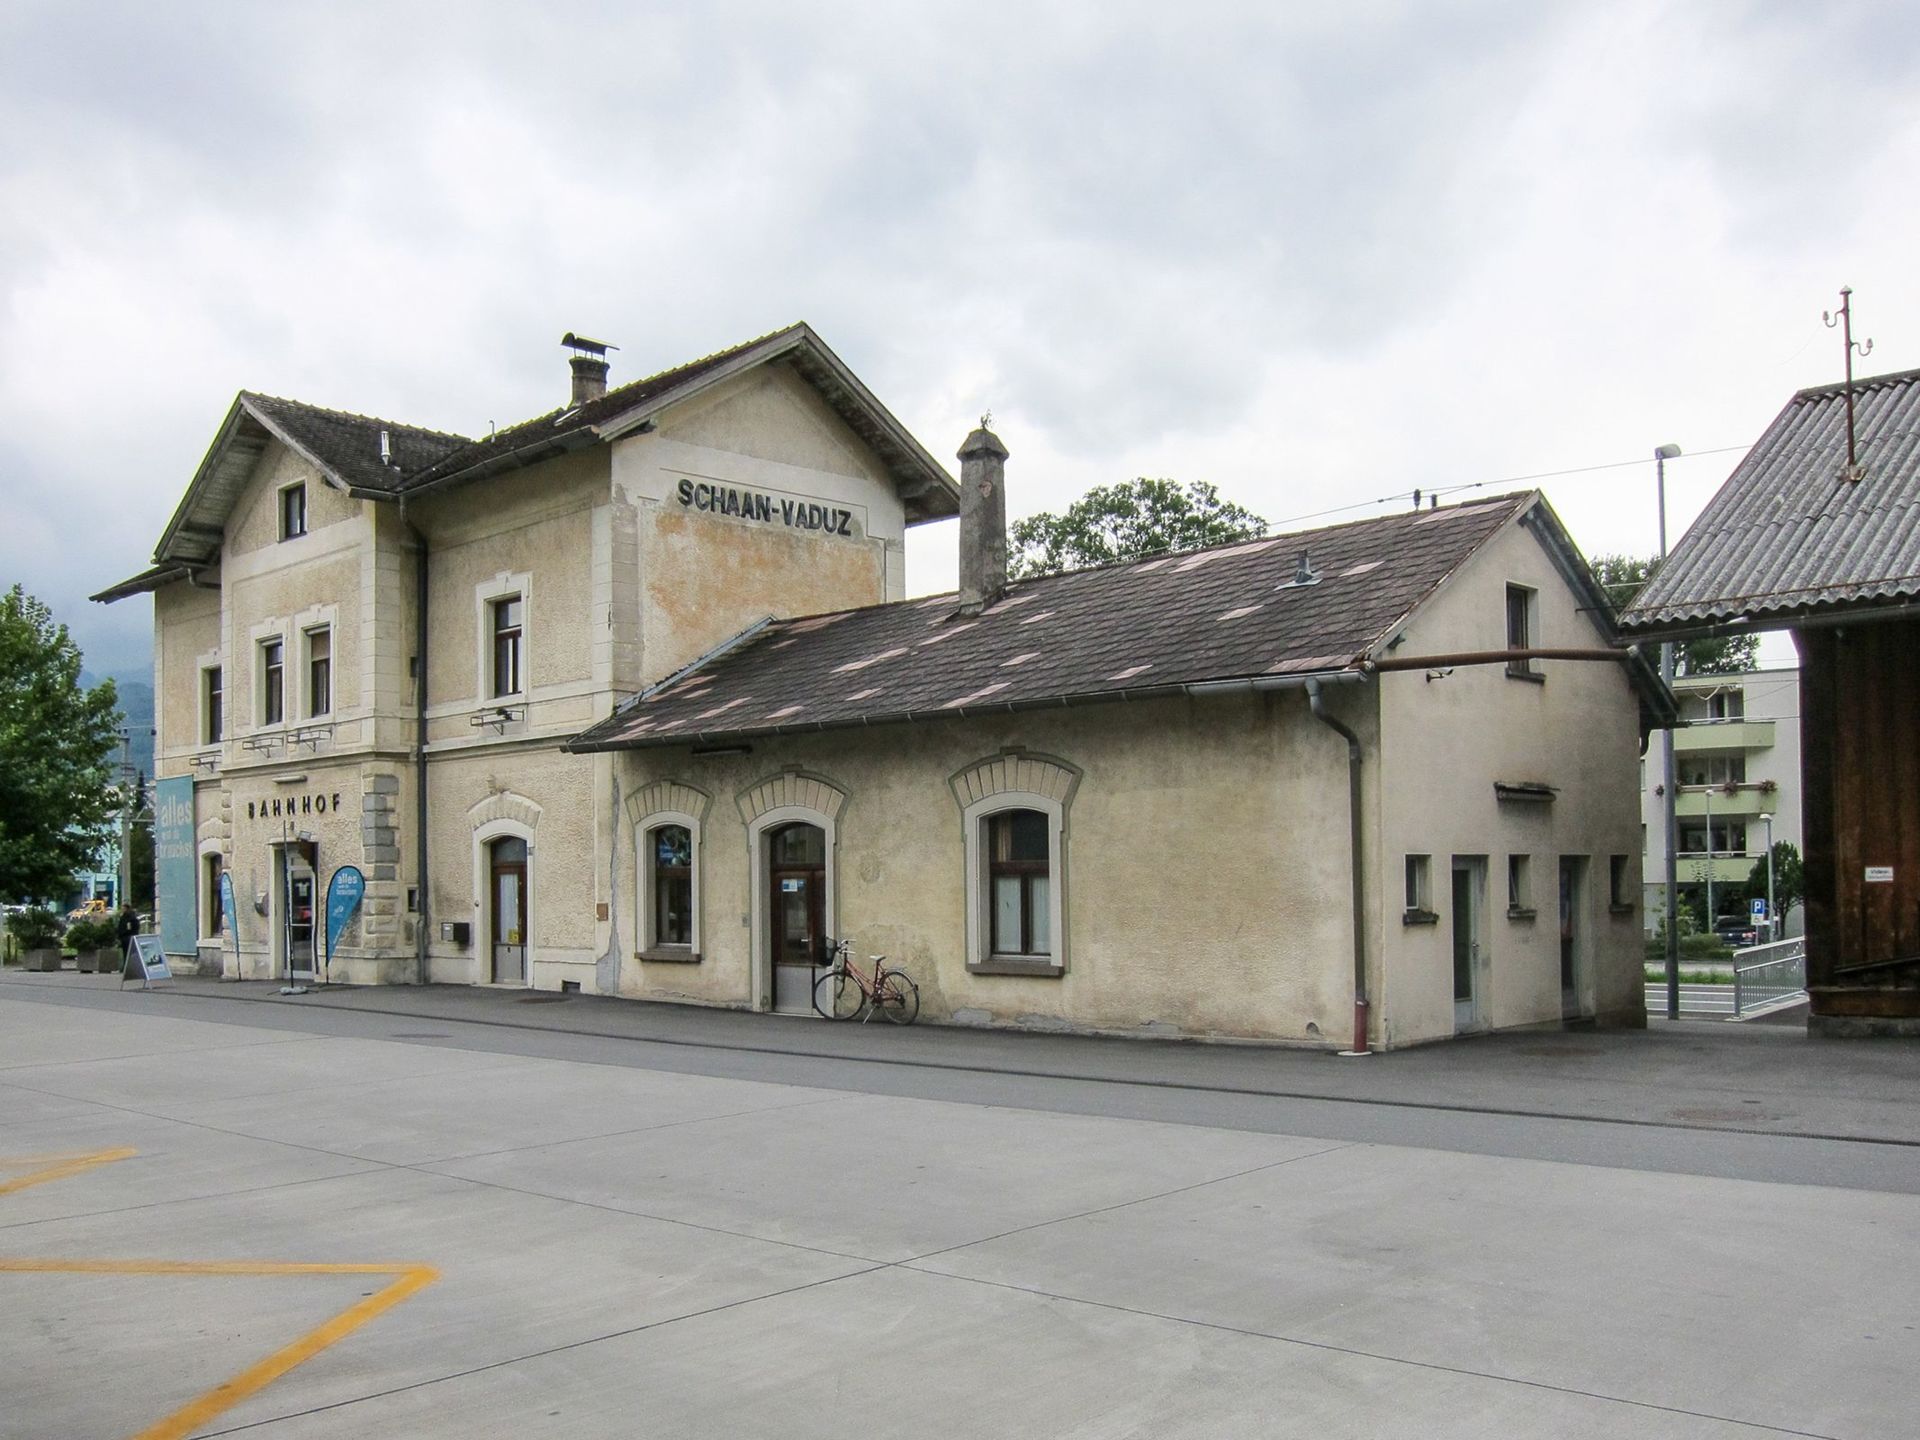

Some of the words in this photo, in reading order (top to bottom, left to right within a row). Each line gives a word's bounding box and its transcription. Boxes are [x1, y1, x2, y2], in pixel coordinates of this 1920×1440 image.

[677, 479, 851, 536] SCHAAN-VADUZ
[161, 795, 192, 828] alles
[248, 793, 340, 820] BAHNHOF
